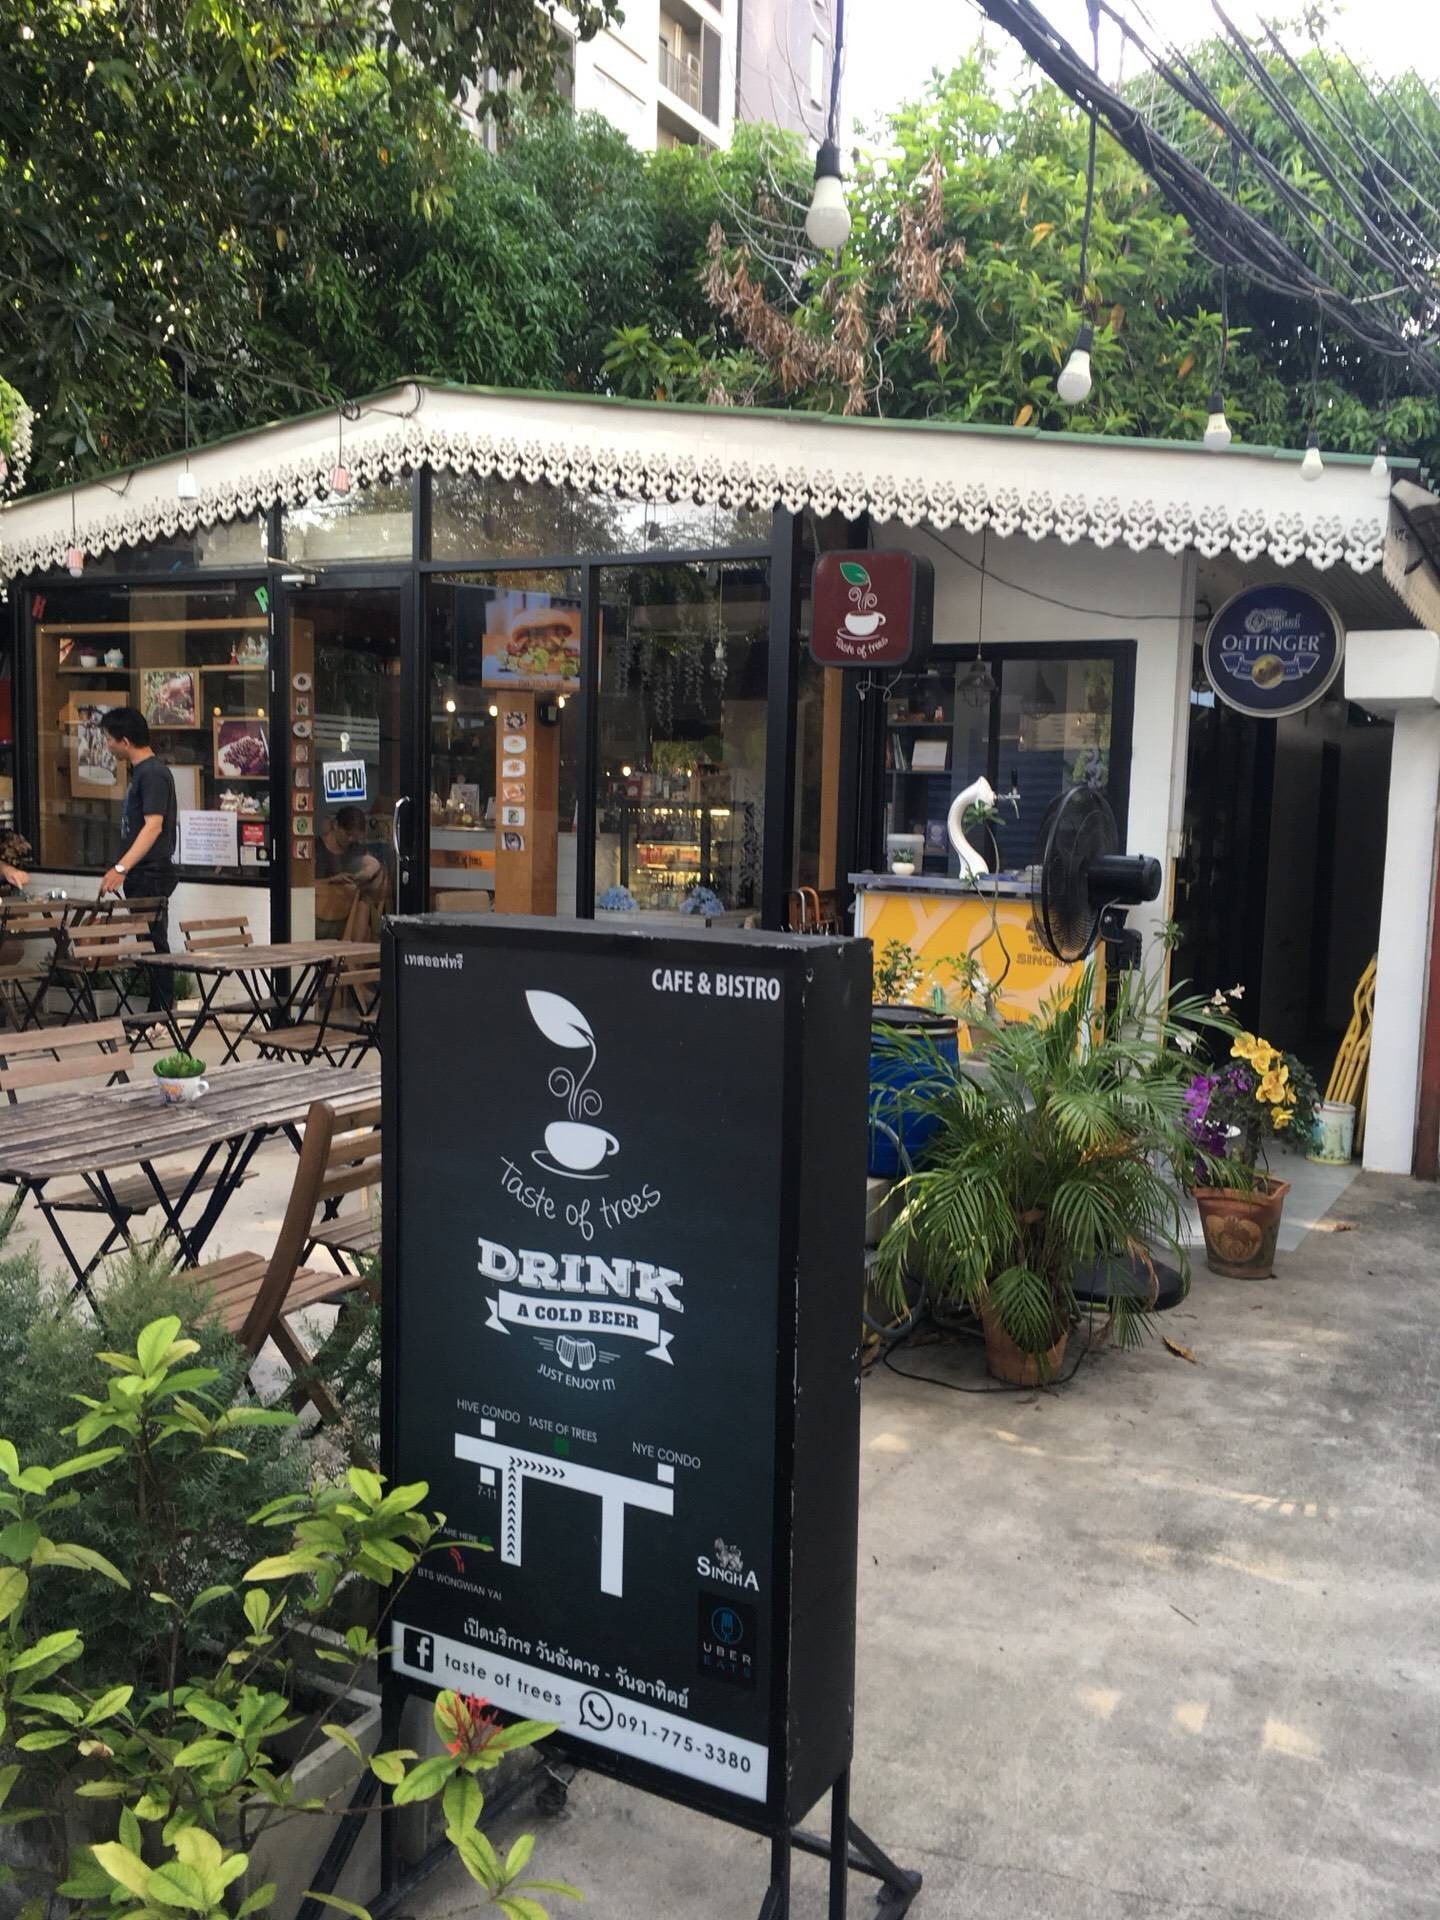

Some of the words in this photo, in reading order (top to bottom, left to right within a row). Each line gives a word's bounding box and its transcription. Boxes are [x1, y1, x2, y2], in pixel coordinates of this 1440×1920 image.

[836, 636, 854, 655] Taste
[856, 644, 867, 660] of
[868, 636, 889, 654] trees
[328, 768, 362, 791] OPEN
[404, 952, 464, 970] เทสออฟทรี
[652, 968, 694, 993] CAFE
[697, 972, 711, 995] &
[716, 973, 780, 1001] BISTRO
[501, 1156, 556, 1219] Taste
[566, 1199, 594, 1241] of
[600, 1184, 661, 1229] trees
[478, 1237, 684, 1313] DRINK
[517, 1303, 529, 1318] A
[535, 1305, 582, 1322] COLD
[589, 1309, 639, 1330] BEER
[537, 1363, 564, 1383] JUST
[565, 1375, 600, 1391] ENJOY
[602, 1378, 616, 1391] IT!
[457, 1398, 479, 1414] HIVE
[481, 1404, 520, 1423] CONDO
[528, 1416, 553, 1432] TASTE
[555, 1422, 569, 1436] OF
[572, 1426, 598, 1443] TREES
[632, 1441, 655, 1459] NYE
[657, 1448, 701, 1470] CONDO
[477, 1484, 497, 1500] 7-11
[443, 1526, 457, 1537] ARE
[459, 1531, 478, 1543] HERE
[418, 1567, 434, 1580] BTS
[436, 1573, 485, 1596] WONGWIAN
[487, 1588, 502, 1601] YAI
[697, 1555, 760, 1592] SINGHA
[463, 1617, 532, 1656] เปิดบริการ
[536, 1640, 600, 1678] วันอังคาร
[615, 1665, 690, 1709] วันอาทิตย์
[703, 1641, 752, 1666] UBER
[445, 1653, 486, 1680] taste
[494, 1673, 511, 1688] of
[517, 1677, 562, 1706] trees
[617, 1712, 751, 1773] 091-775-3380
